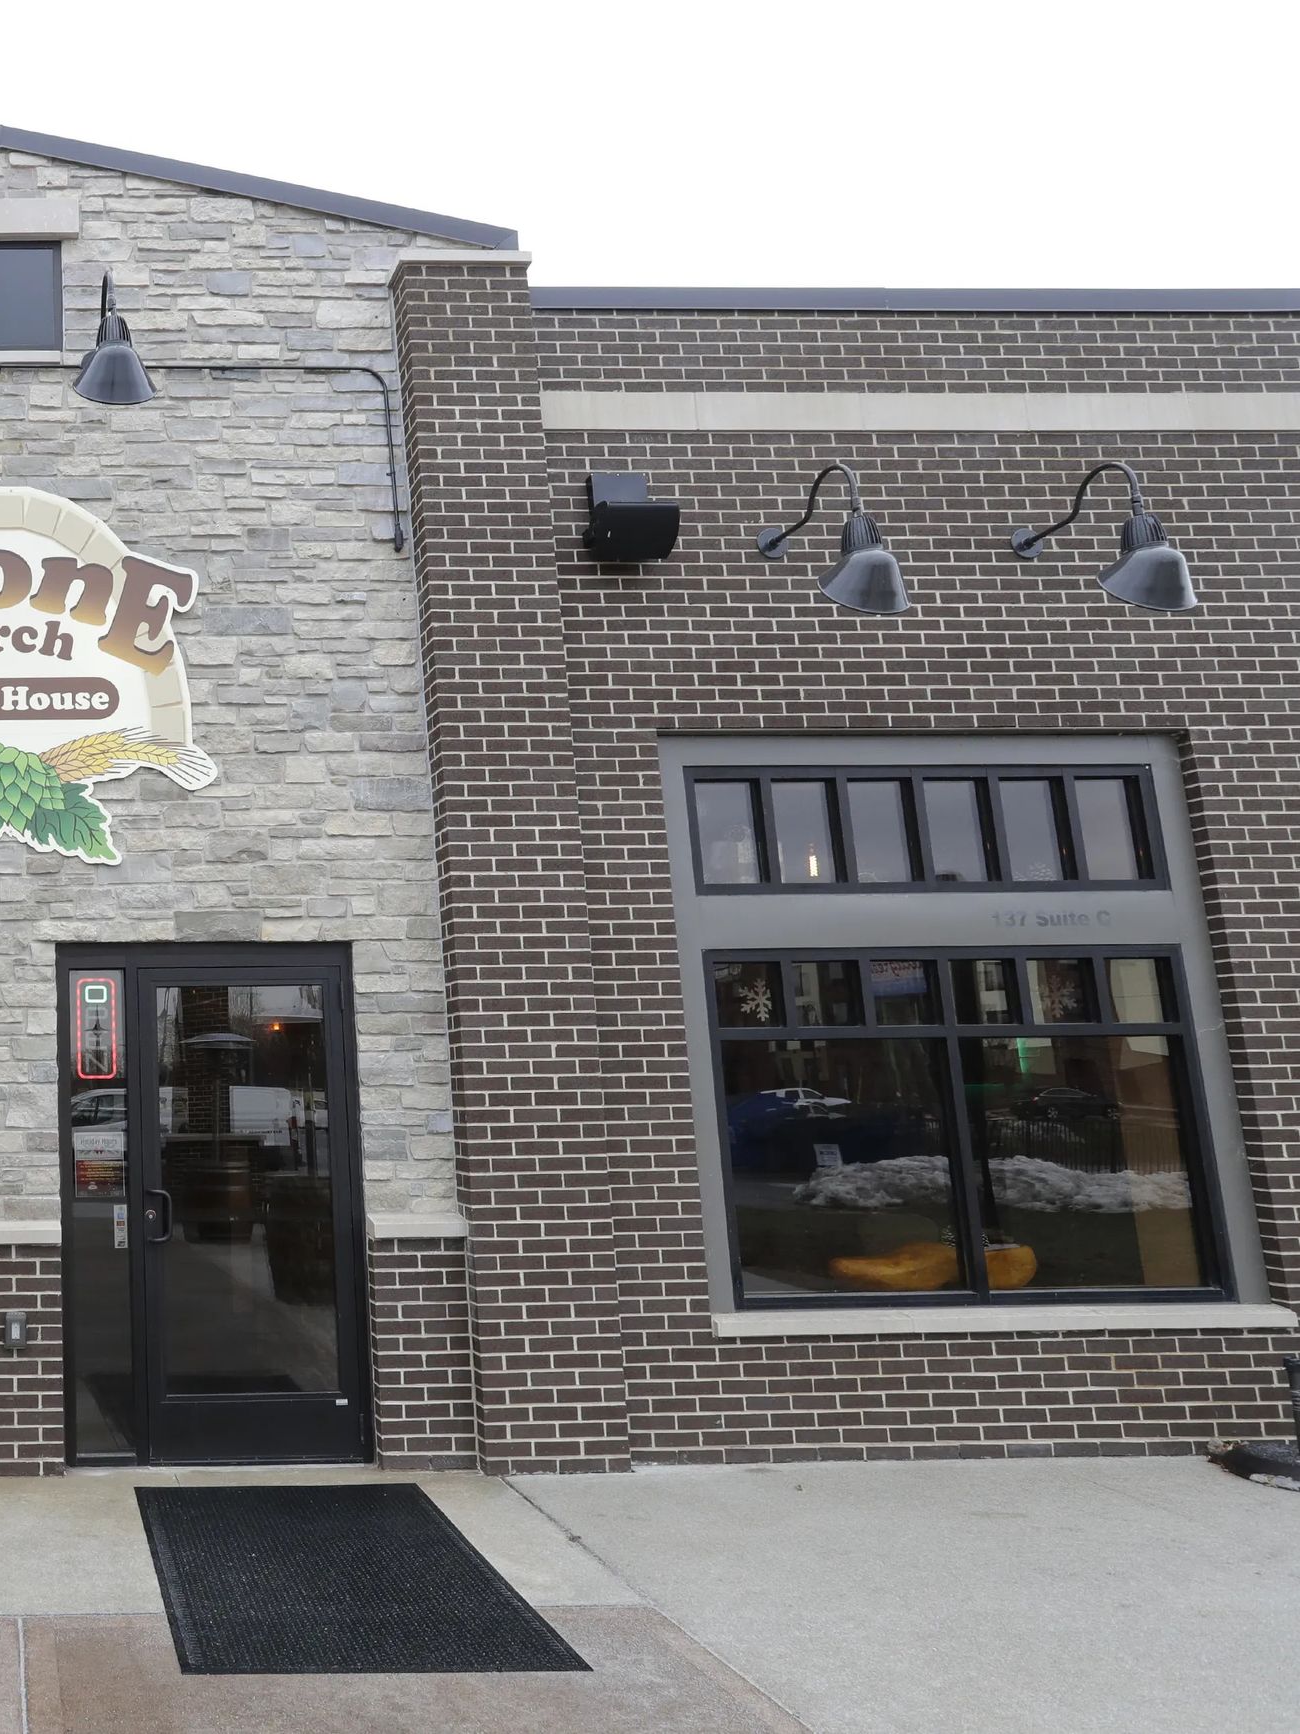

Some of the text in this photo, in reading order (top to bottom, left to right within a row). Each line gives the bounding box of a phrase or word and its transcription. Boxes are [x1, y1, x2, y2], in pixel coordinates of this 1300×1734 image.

[0, 685, 111, 712] House
[991, 910, 1028, 927] 137
[1035, 910, 1091, 927] Suite
